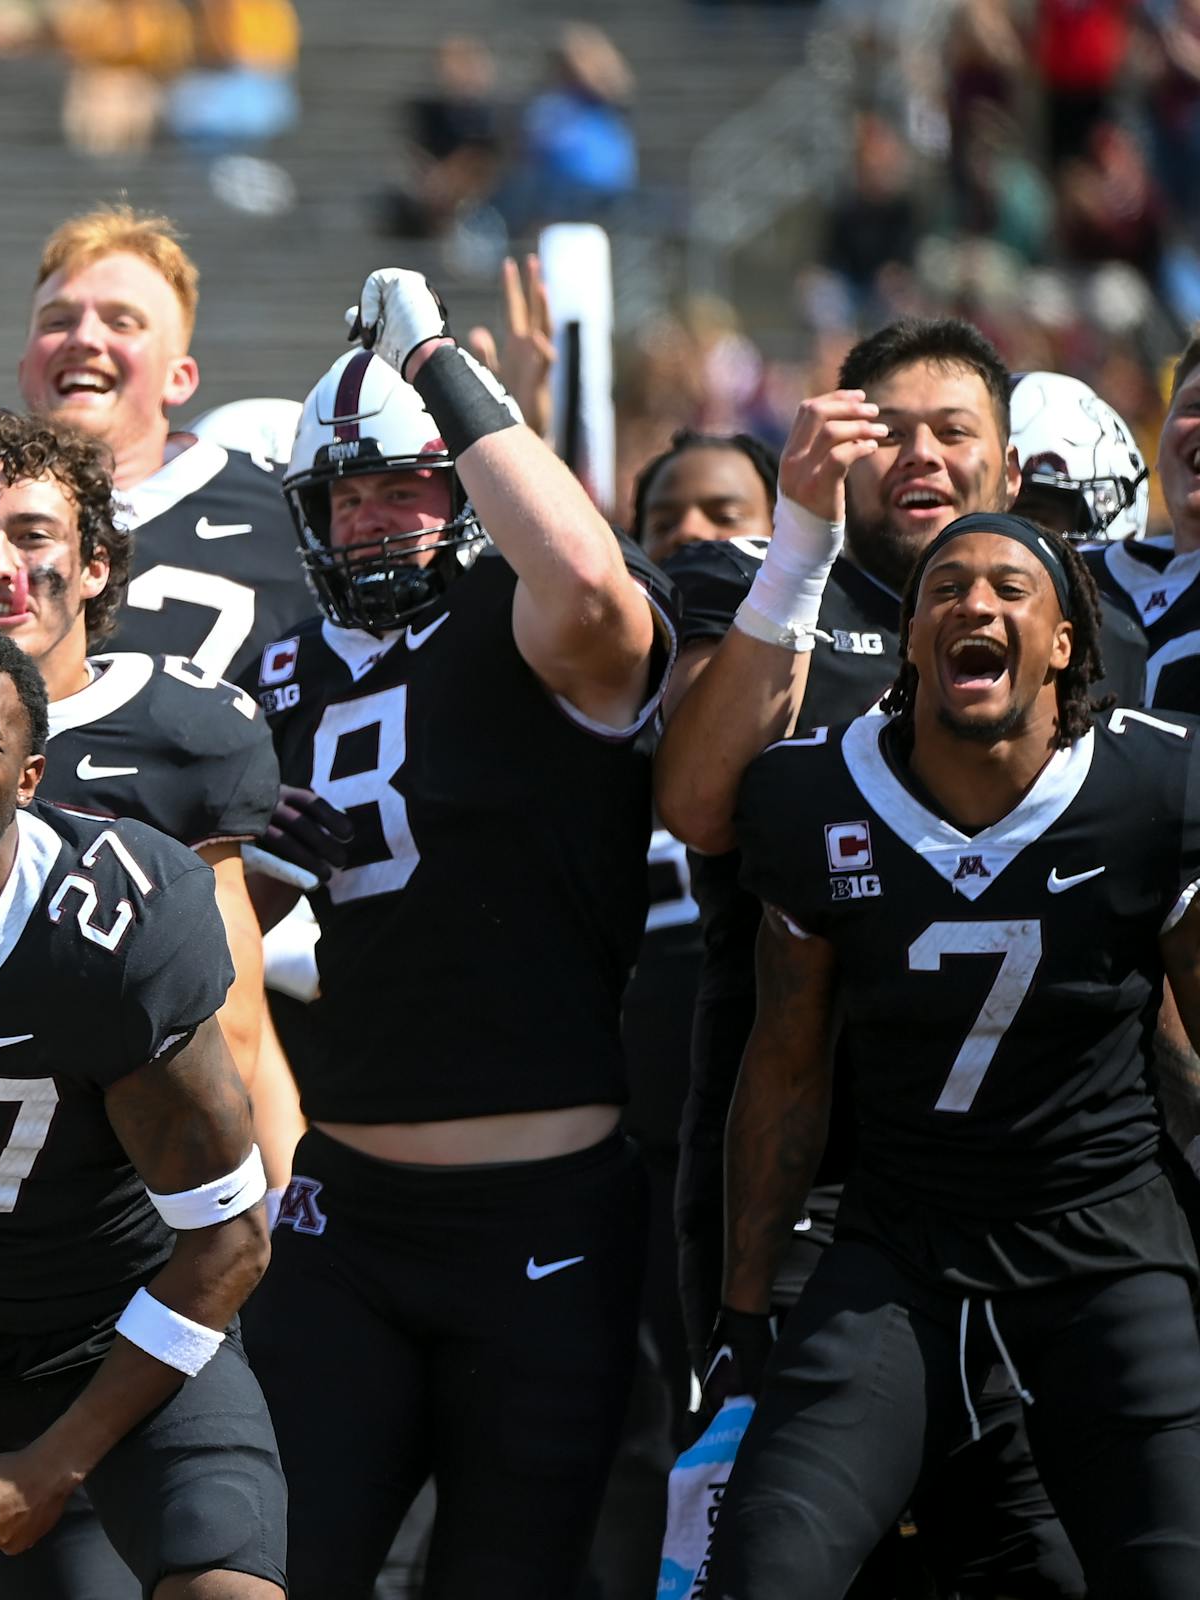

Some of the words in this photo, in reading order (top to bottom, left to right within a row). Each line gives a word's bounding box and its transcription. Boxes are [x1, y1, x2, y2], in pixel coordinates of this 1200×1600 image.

[309, 683, 422, 906] 8
[953, 854, 992, 880] M
[48, 827, 155, 955] 27
[906, 917, 1044, 1113] 7
